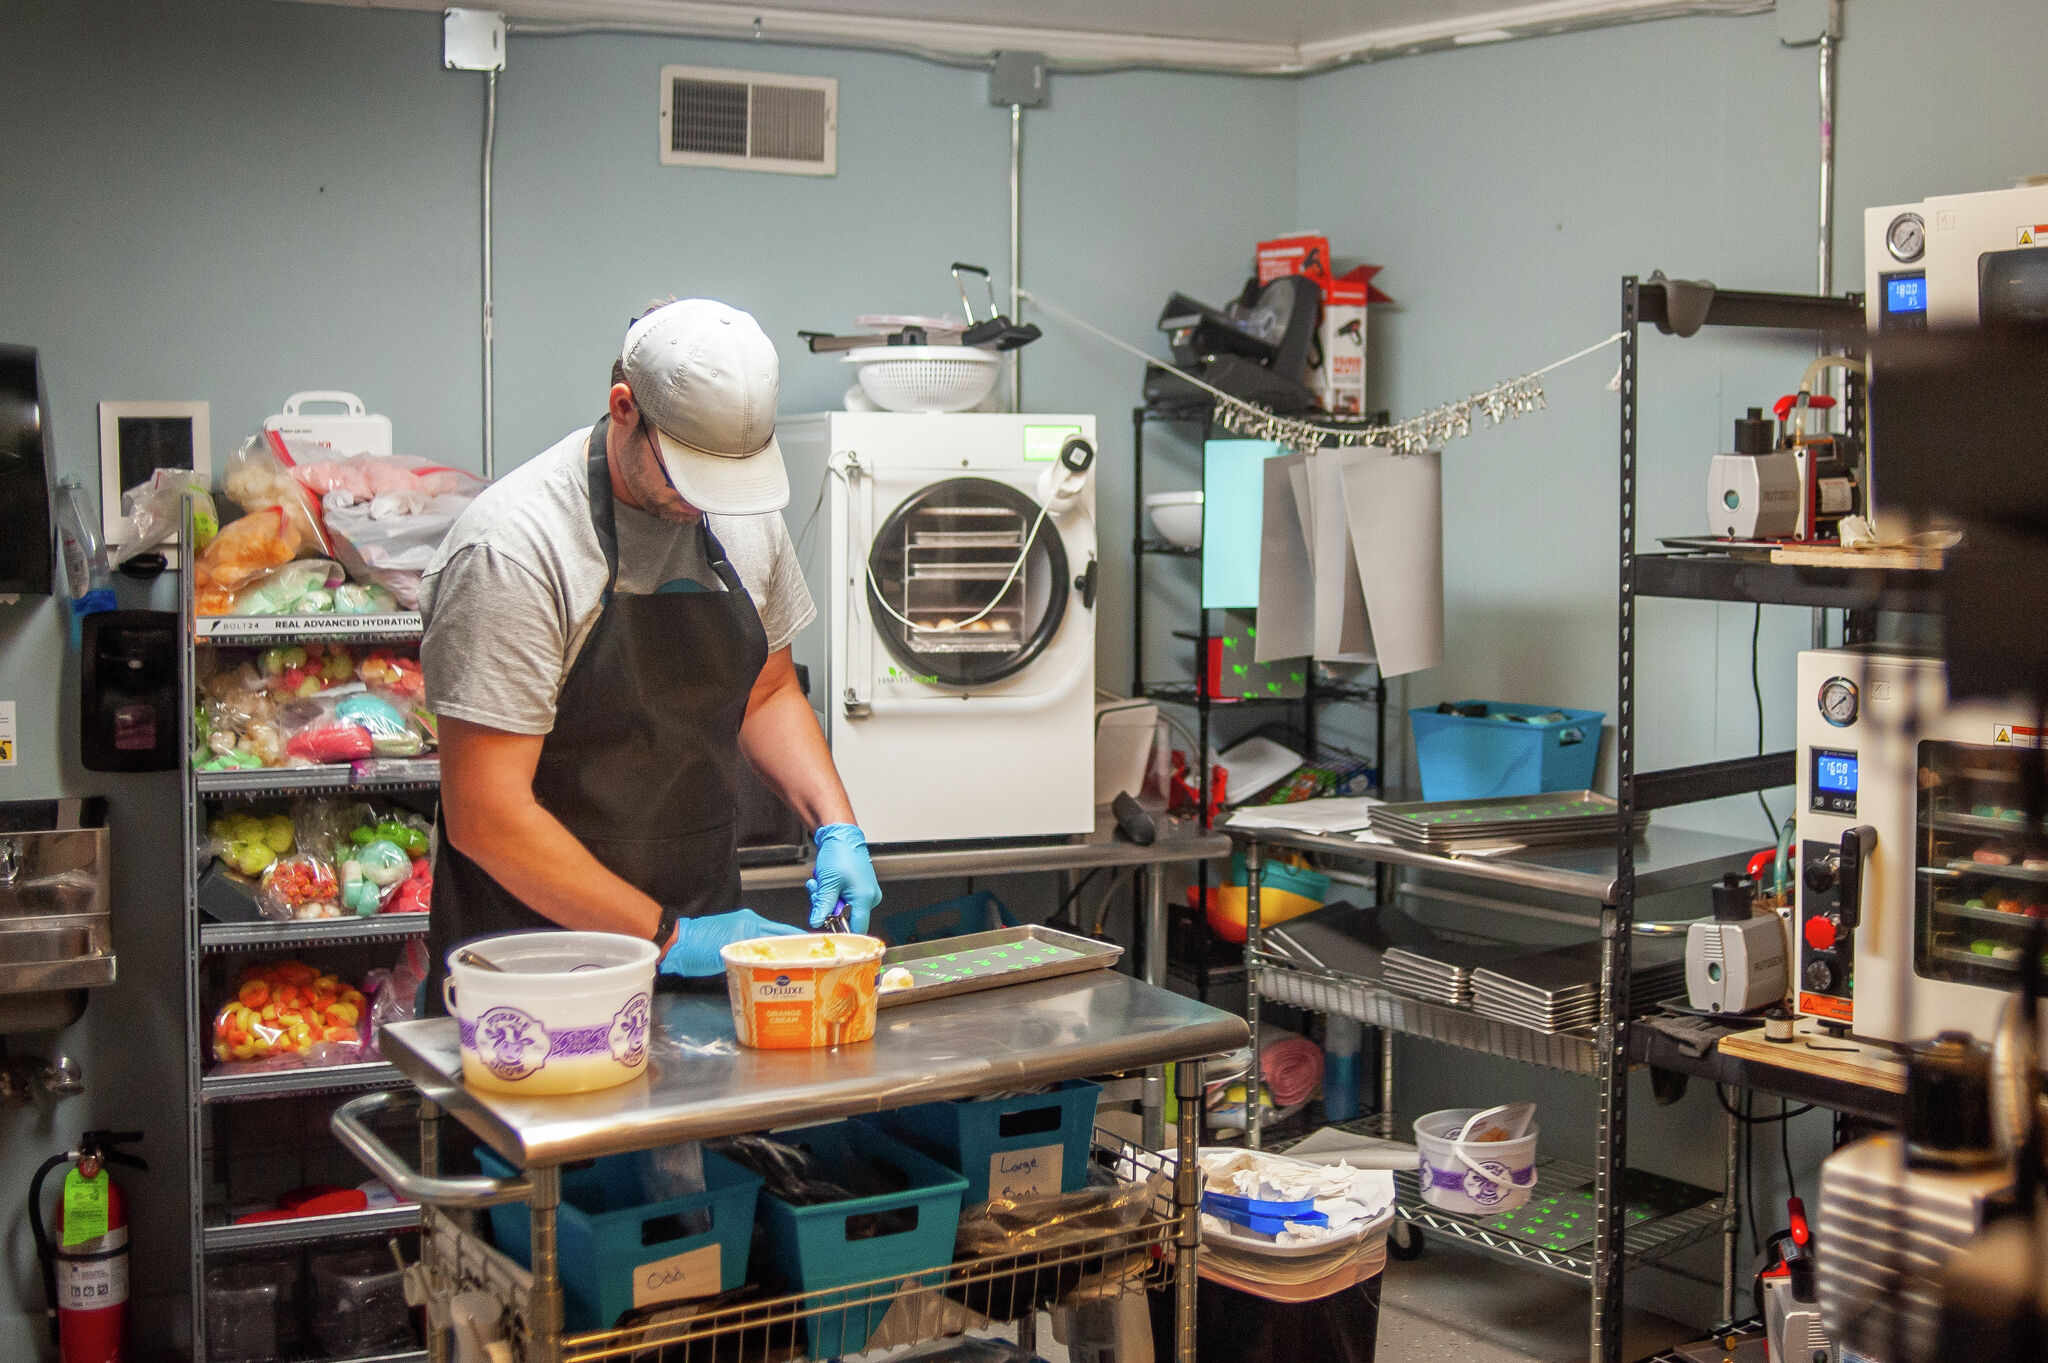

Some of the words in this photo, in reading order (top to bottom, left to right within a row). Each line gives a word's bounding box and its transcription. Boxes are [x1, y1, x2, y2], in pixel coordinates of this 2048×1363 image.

[223, 622, 260, 630] BOLT24
[275, 620, 300, 629] REAL
[303, 618, 360, 628] ADVANCED
[362, 616, 421, 627] HYDRATION
[766, 1009, 802, 1018] ORANGE
[769, 1017, 799, 1025] CREAM
[1001, 1156, 1037, 1174] Large
